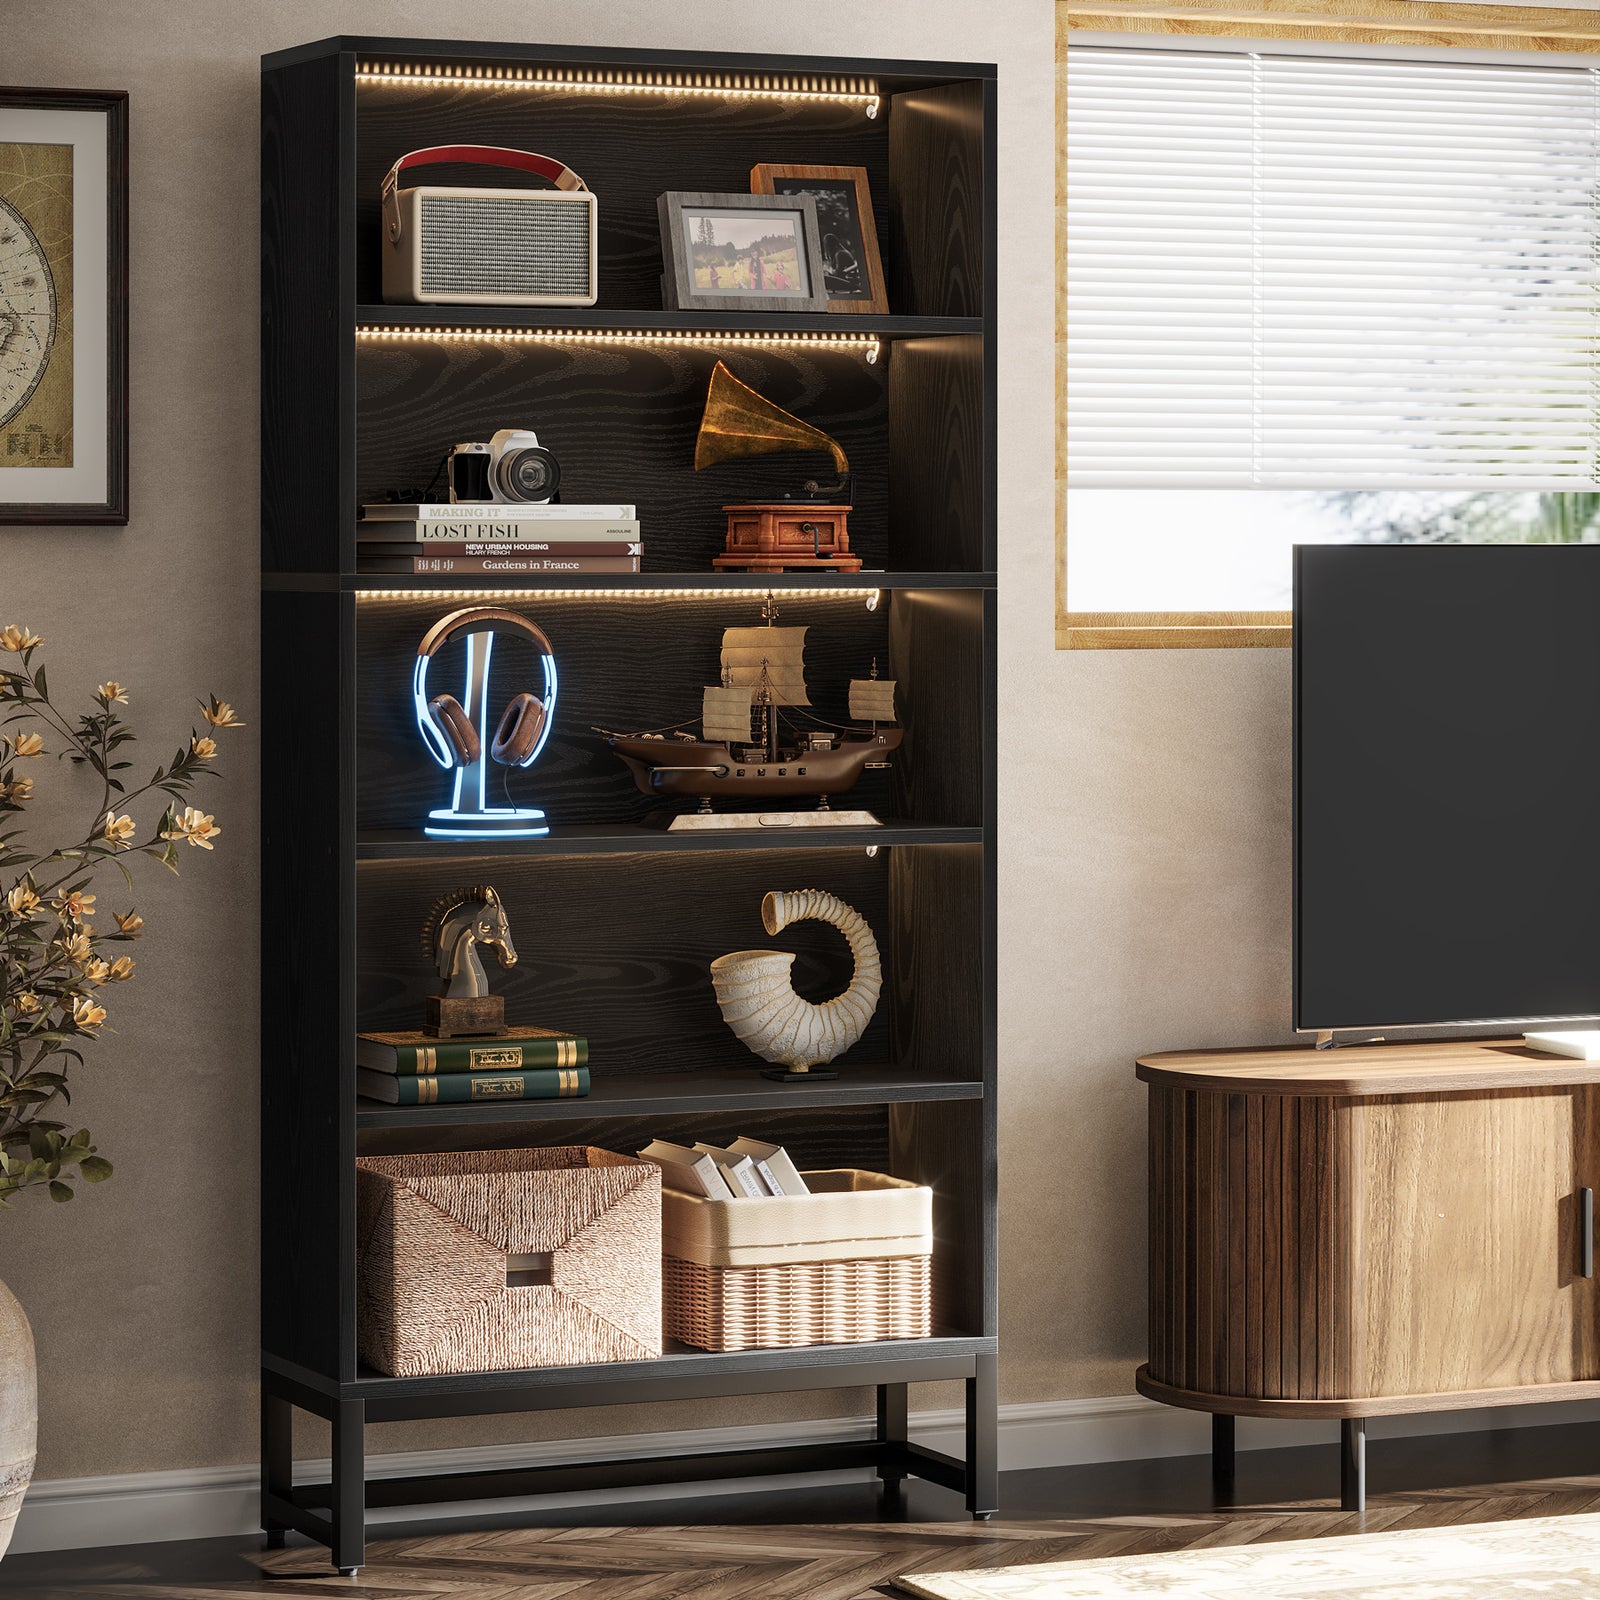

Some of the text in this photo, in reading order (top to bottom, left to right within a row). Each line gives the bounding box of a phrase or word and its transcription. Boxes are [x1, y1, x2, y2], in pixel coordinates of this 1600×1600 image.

[429, 508, 483, 517] MAKING
[487, 508, 501, 517] IT
[423, 524, 519, 538] LOST FISH
[482, 560, 580, 569] Gardens in France
